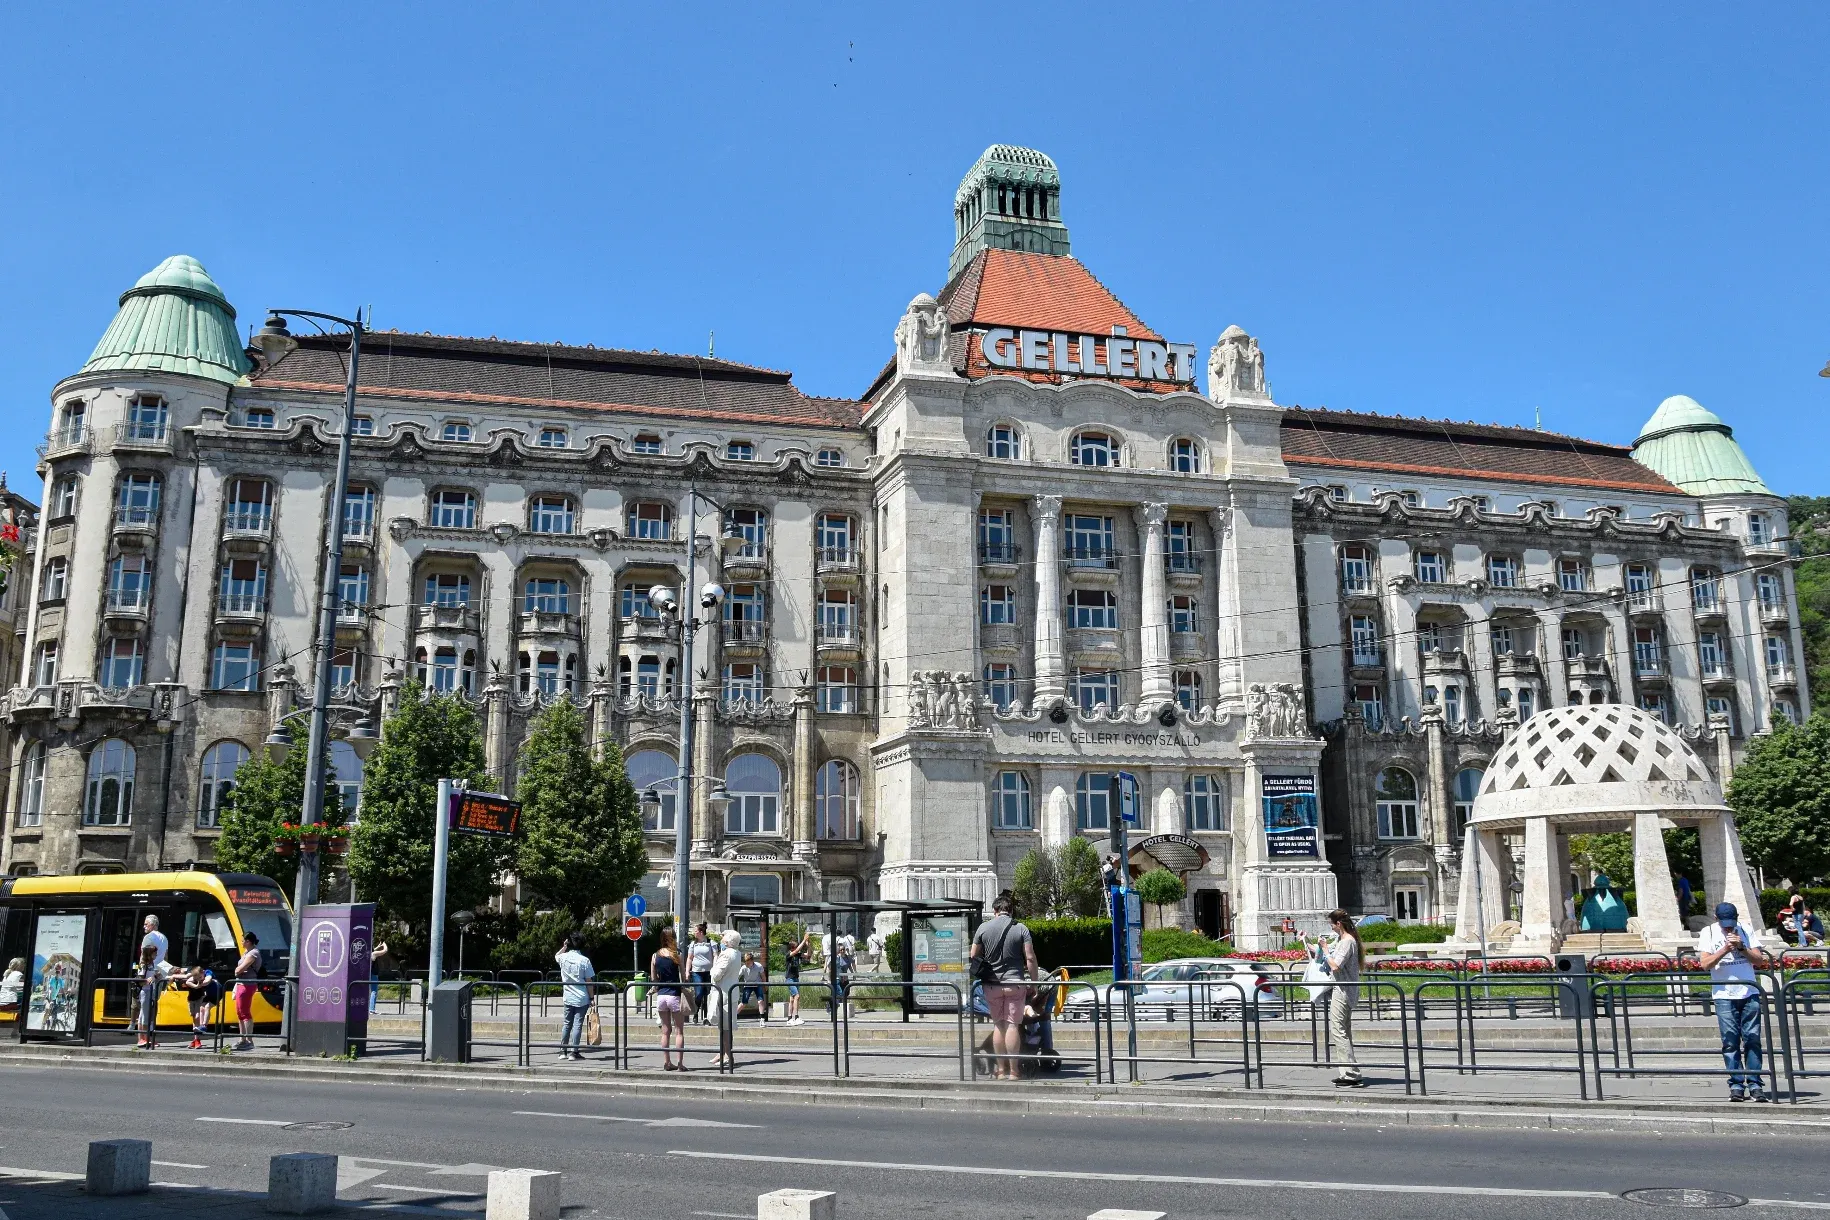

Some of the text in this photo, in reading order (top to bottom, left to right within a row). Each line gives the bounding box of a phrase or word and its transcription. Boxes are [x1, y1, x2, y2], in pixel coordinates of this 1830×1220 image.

[1028, 730, 1201, 747] HOTEL GELLÉRT GYÓGYSZÁLLÓ
[1141, 835, 1167, 849] HOTEL
